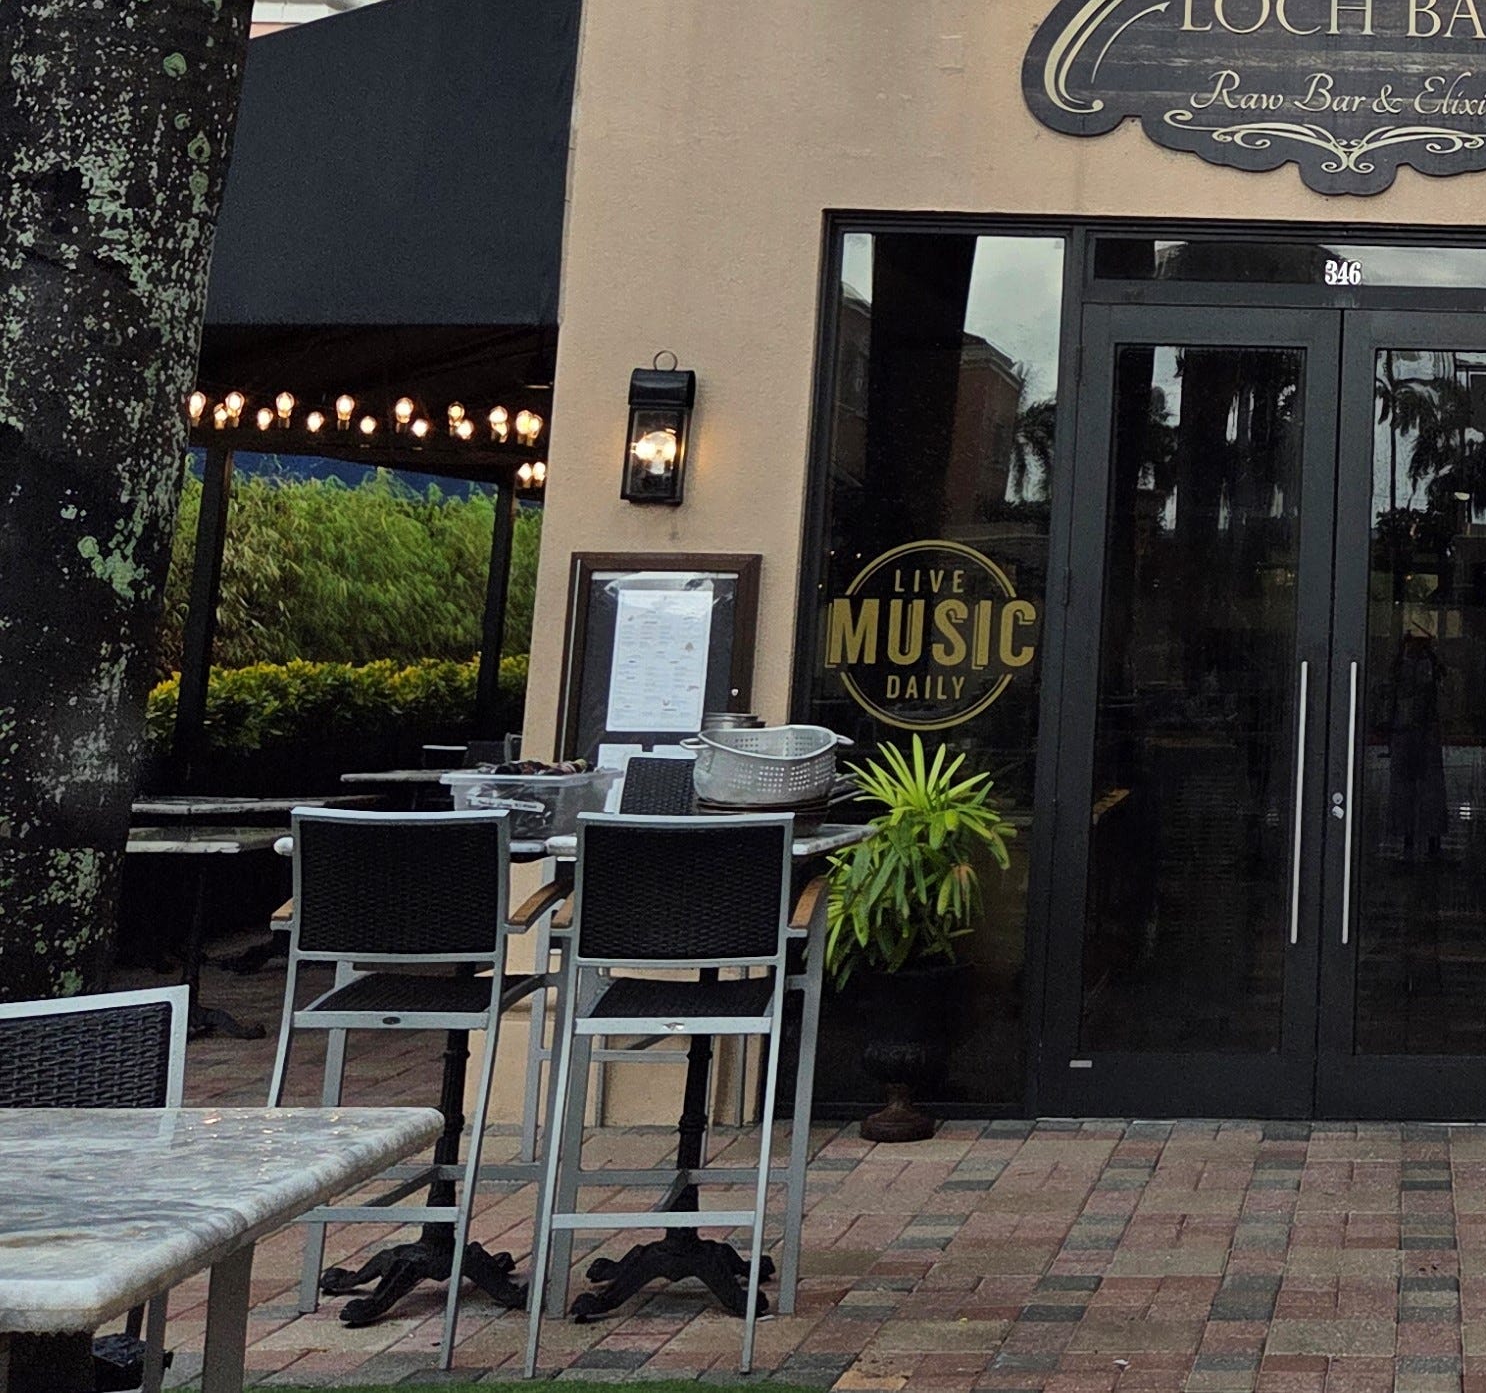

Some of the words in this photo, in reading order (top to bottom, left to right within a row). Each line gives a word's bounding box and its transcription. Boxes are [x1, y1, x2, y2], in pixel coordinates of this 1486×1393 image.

[1190, 69, 1284, 110] Raw
[1293, 72, 1366, 112] Bar
[1372, 83, 1404, 115] &
[1324, 259, 1361, 286] 346
[894, 569, 965, 593] LIVE
[825, 598, 1037, 670] MUSIC
[886, 675, 966, 701] DAILY
